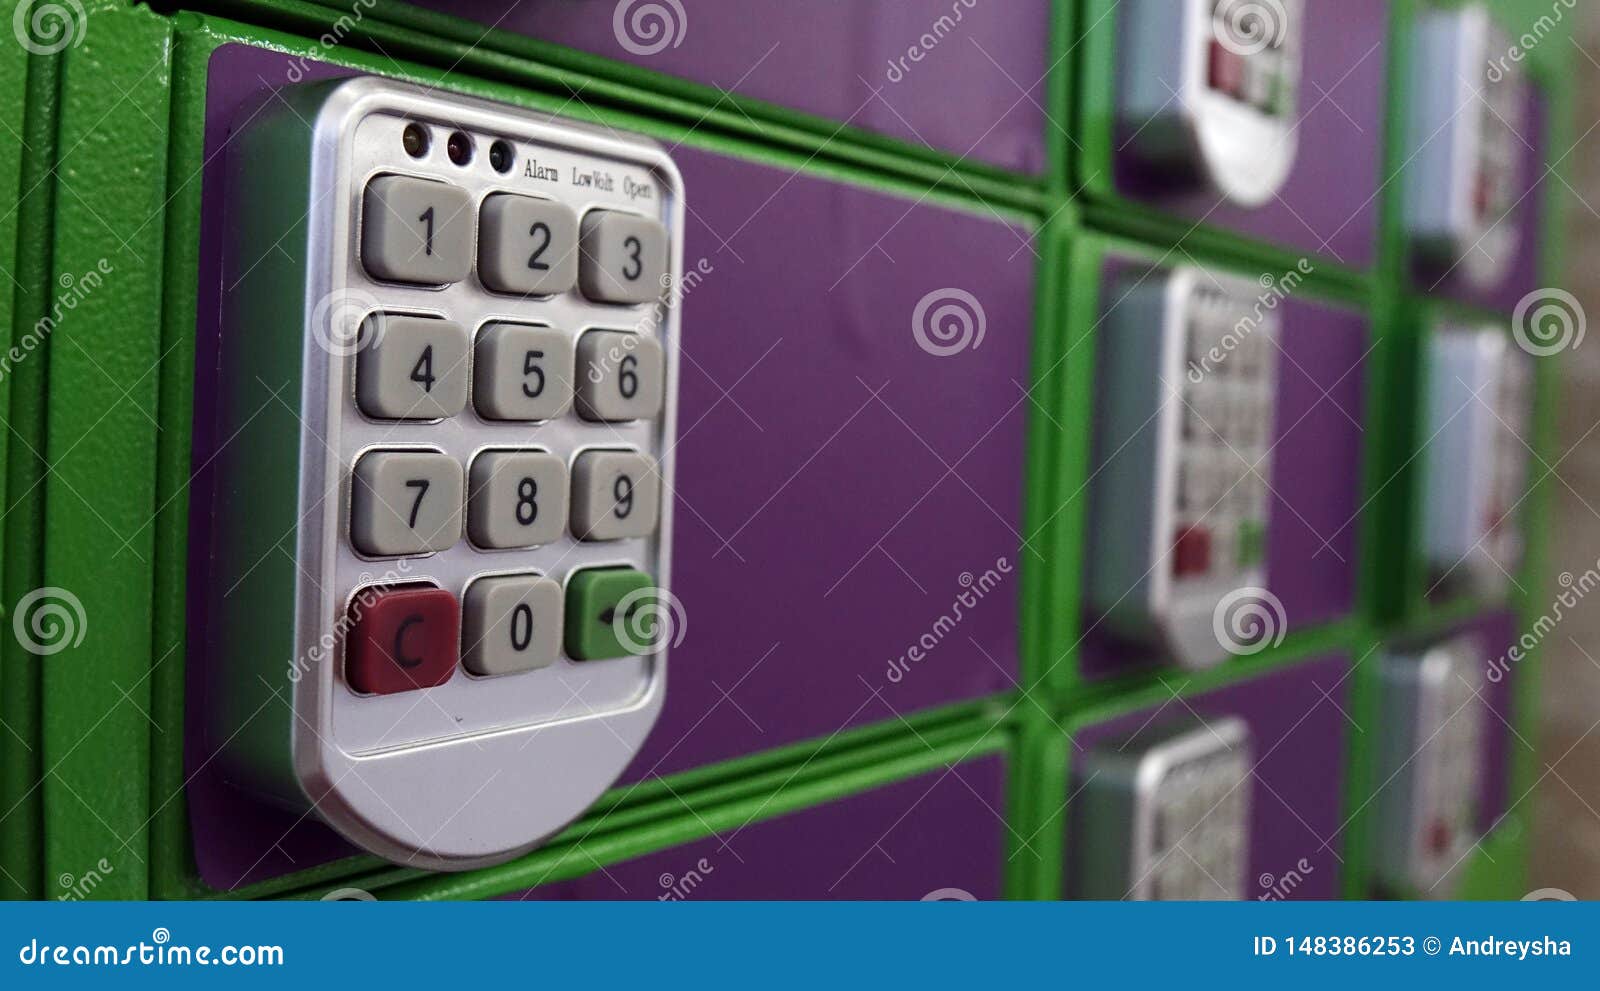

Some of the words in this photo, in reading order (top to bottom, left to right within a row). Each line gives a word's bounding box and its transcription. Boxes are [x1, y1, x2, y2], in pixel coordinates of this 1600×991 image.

[524, 159, 559, 182] Alarm
[623, 175, 652, 201] Open
[418, 206, 435, 256] 1
[527, 222, 552, 271] 2
[621, 235, 643, 281] 3
[409, 344, 435, 393] 4
[522, 350, 546, 399] 5
[618, 355, 638, 400] 6
[405, 479, 430, 529] 7
[515, 476, 538, 526] 8
[613, 474, 634, 520] 9
[393, 614, 425, 669] C
[510, 603, 533, 651] 0
